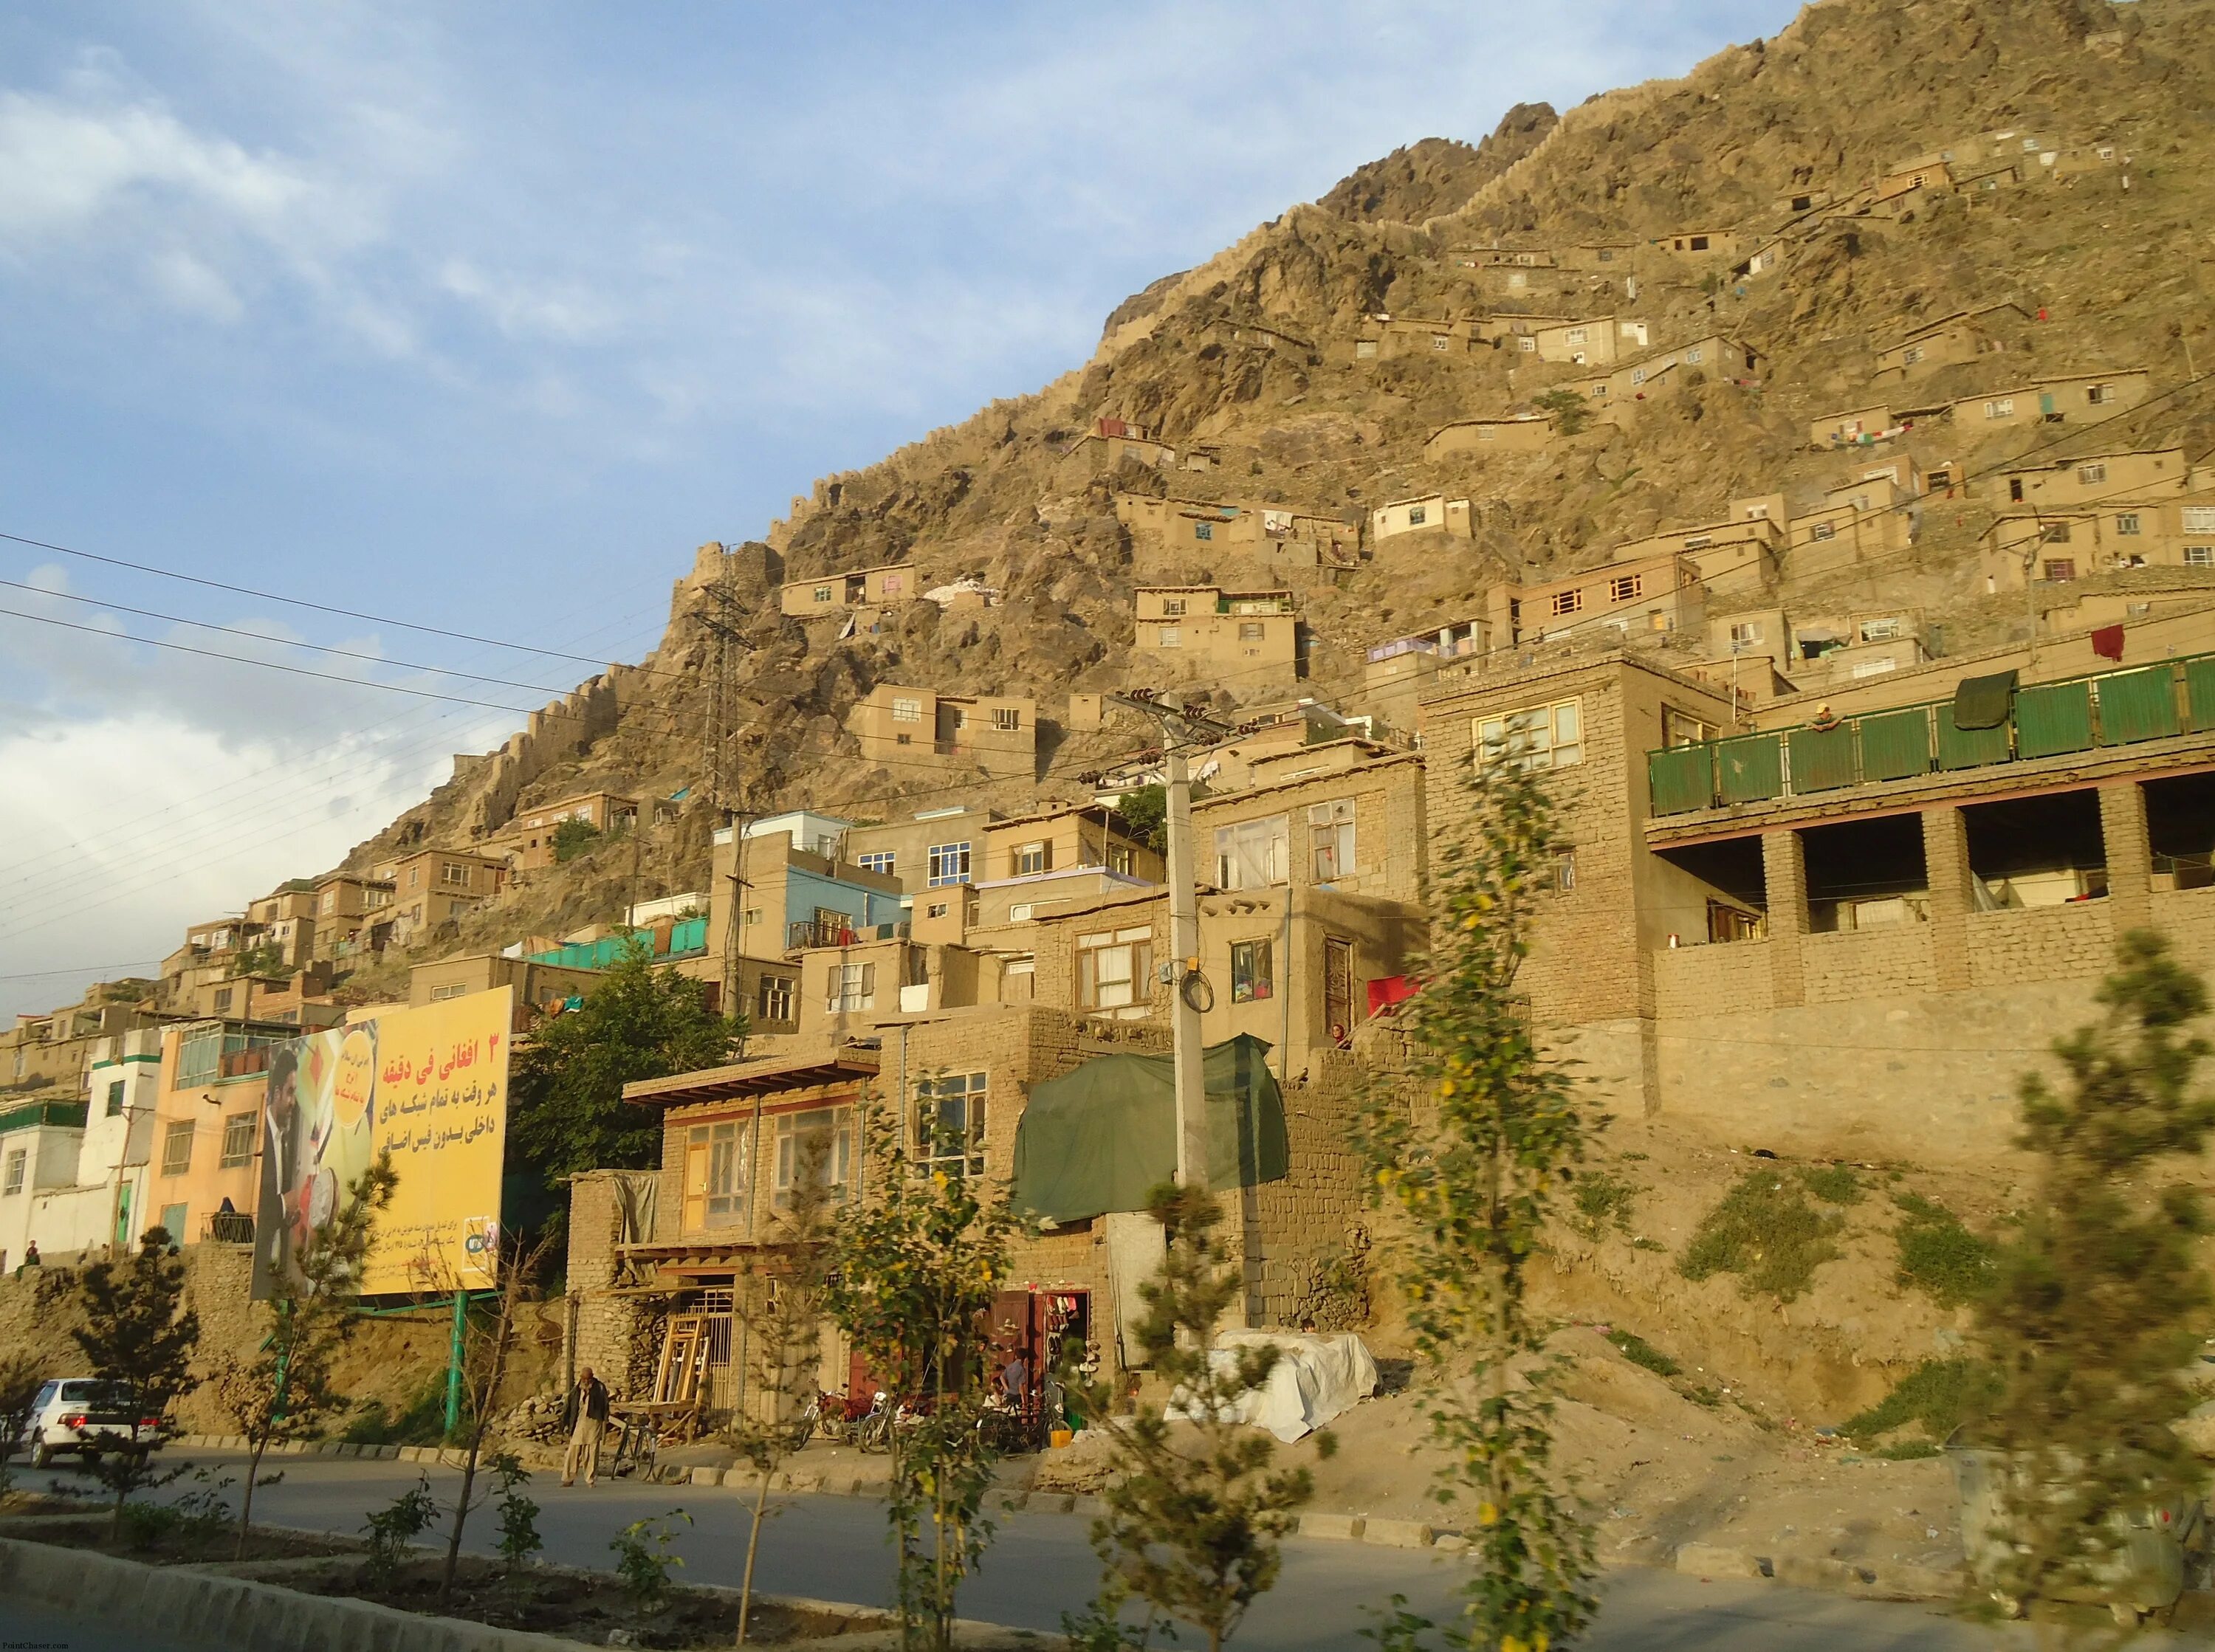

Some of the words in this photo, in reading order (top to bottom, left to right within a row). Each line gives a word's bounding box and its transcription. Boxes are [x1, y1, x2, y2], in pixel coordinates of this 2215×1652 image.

[439, 1039, 478, 1081] افغانی
[490, 1033, 499, 1063] ۳
[382, 1055, 411, 1089] دقیقه
[416, 1048, 434, 1085] فی
[400, 1092, 427, 1117] شبکه
[430, 1088, 449, 1115] تمام
[451, 1090, 459, 1109] به
[462, 1080, 481, 1107] وقت
[485, 1082, 497, 1105] هر
[380, 1098, 397, 1124] های
[412, 1123, 431, 1153] فیس
[433, 1126, 464, 1149] بدون
[465, 1114, 495, 1144] داخلی
[378, 1129, 411, 1159] اضافی
